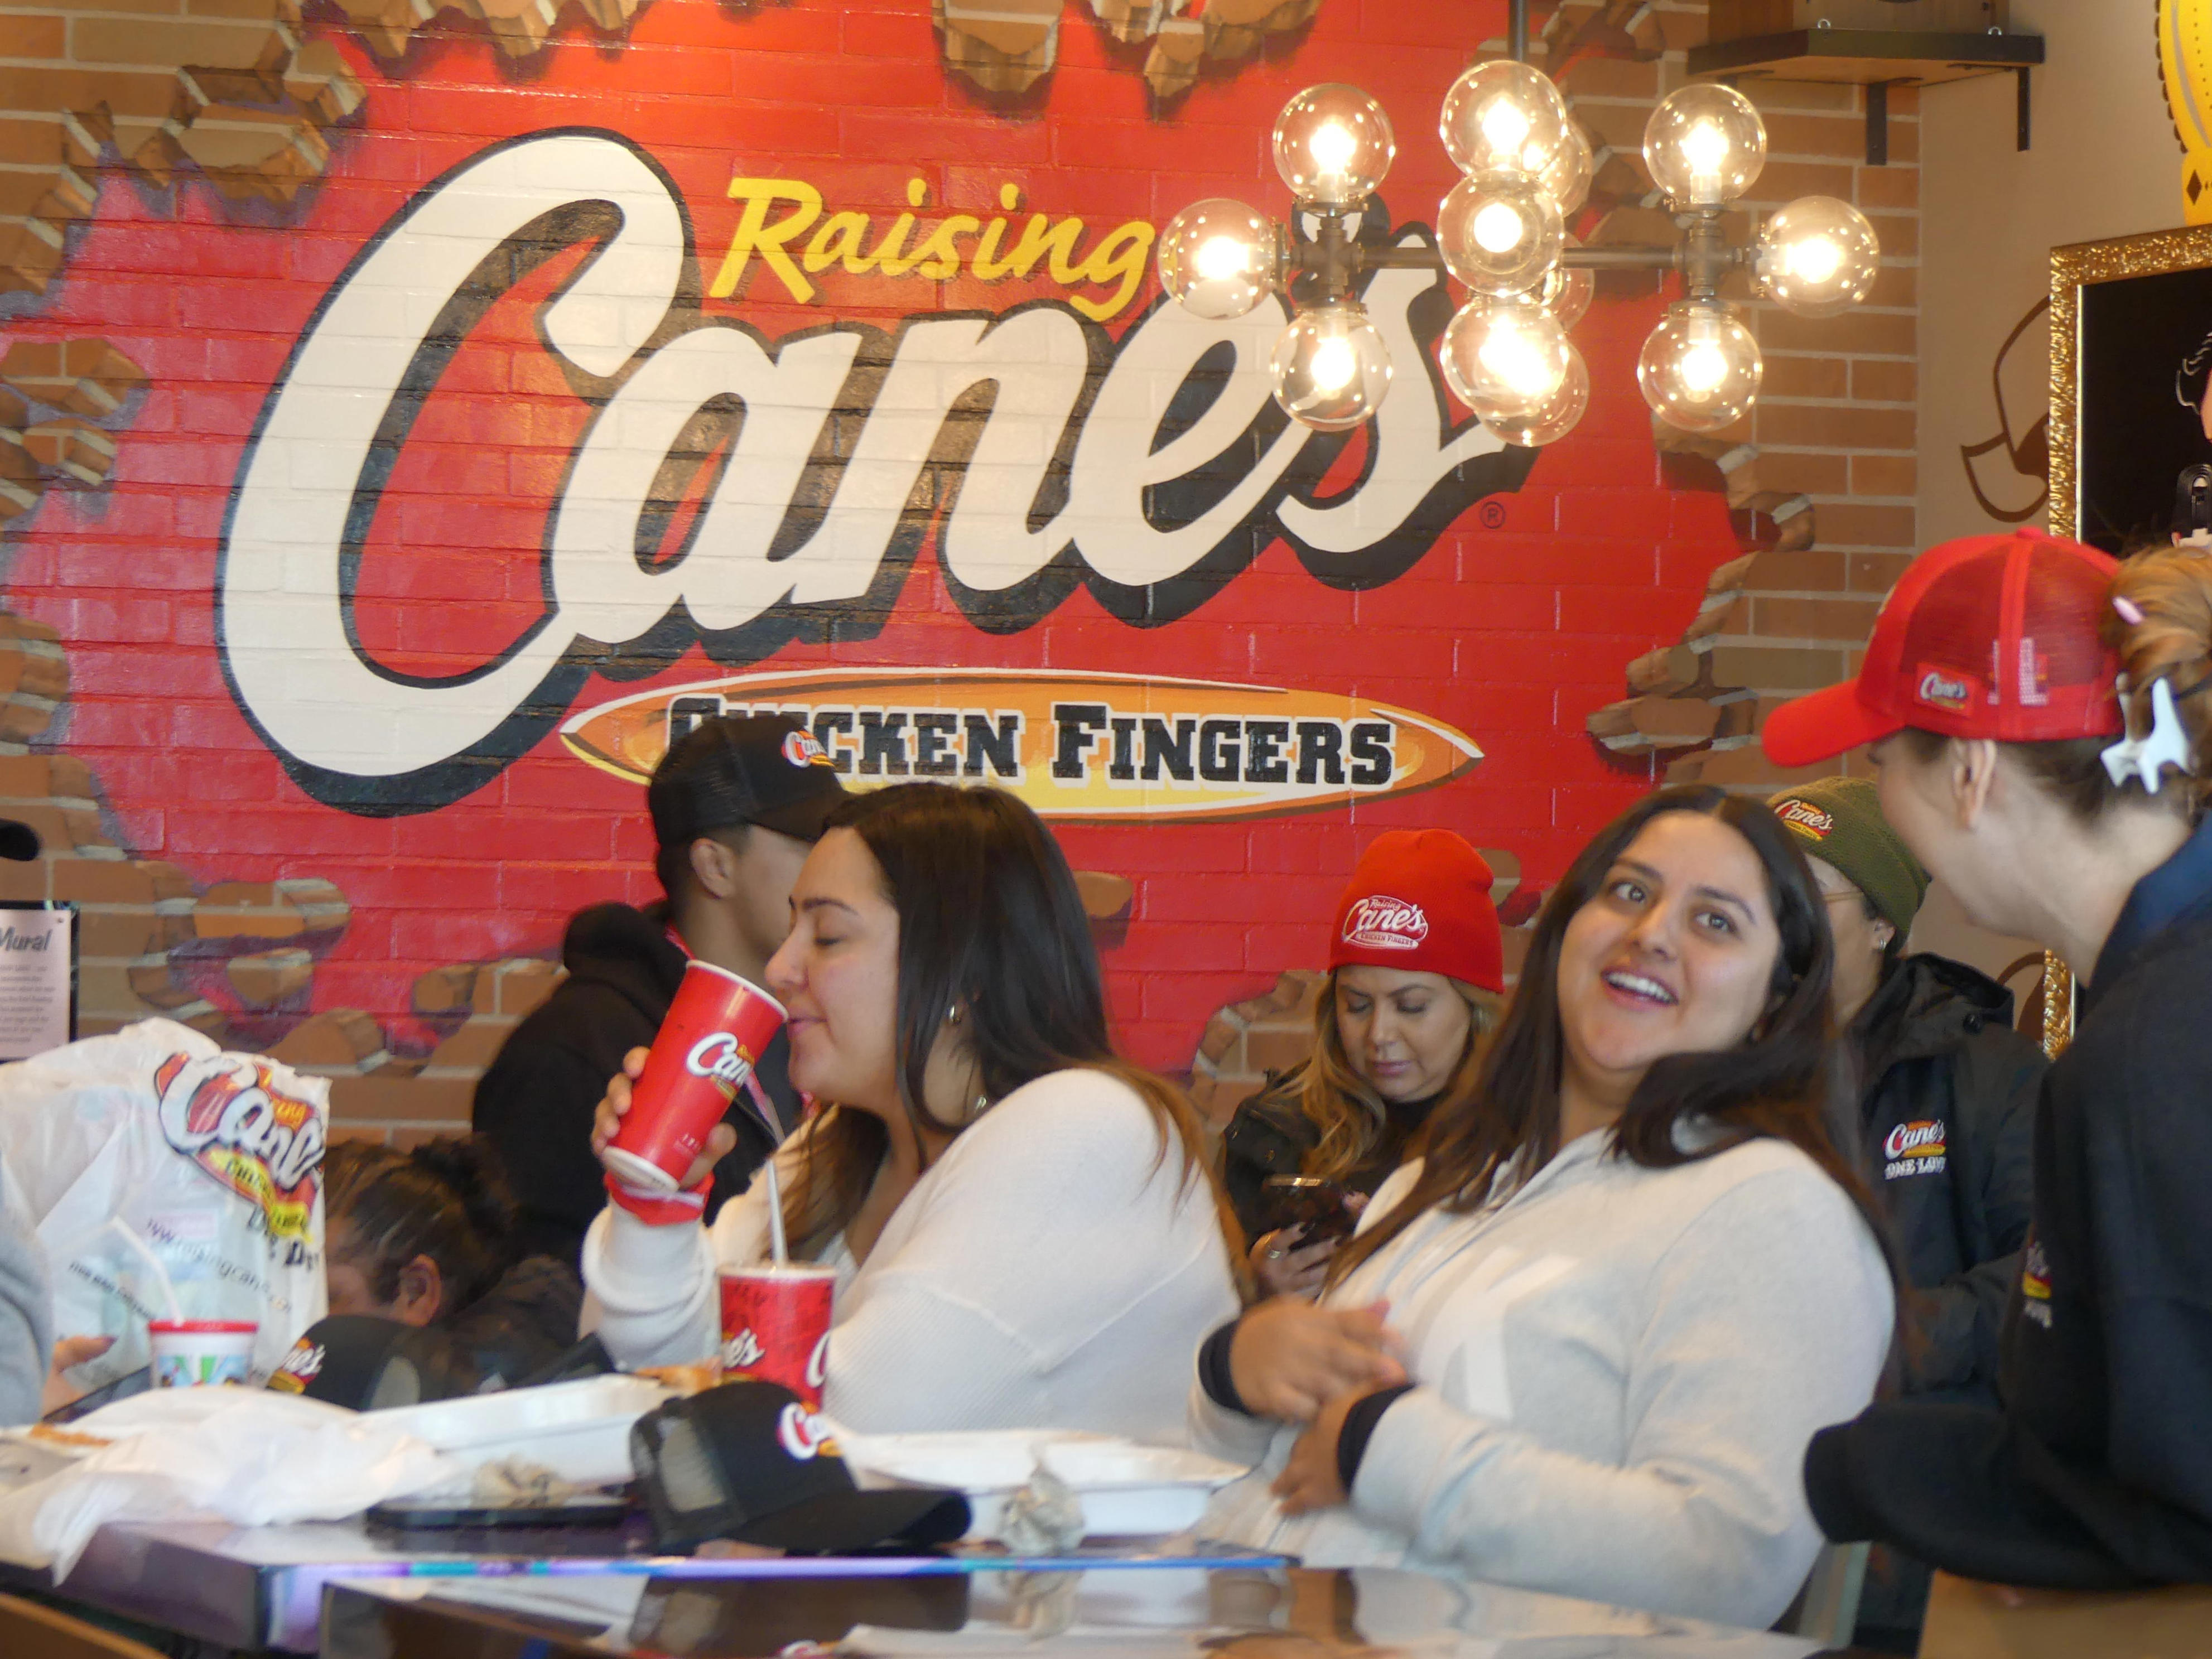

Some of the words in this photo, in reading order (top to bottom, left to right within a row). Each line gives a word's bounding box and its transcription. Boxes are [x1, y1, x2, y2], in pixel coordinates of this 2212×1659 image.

[709, 177, 1155, 322] Raising
[669, 697, 1019, 779] CCKEN
[1052, 701, 1397, 789] FINGERS
[1342, 898, 1428, 943] Cane's
[1885, 1118, 1946, 1160] Cane's
[1885, 1159, 1916, 1180] ONE
